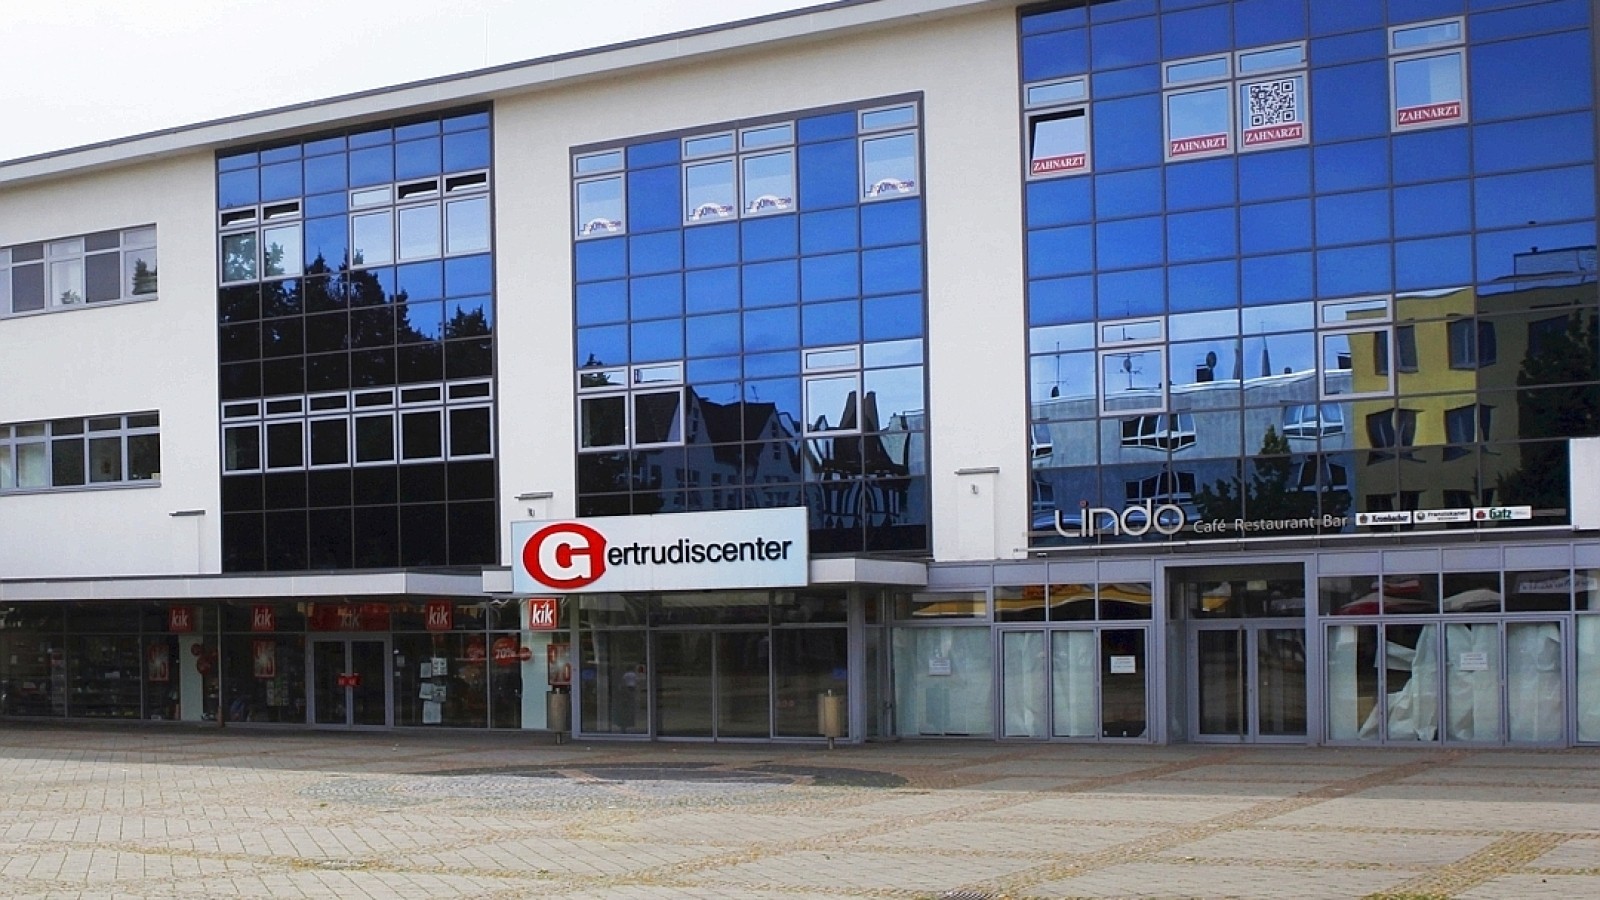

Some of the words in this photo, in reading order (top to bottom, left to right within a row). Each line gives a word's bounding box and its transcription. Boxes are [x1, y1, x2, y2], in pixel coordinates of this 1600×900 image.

[1400, 105, 1459, 122] ZAHNARZT
[1245, 127, 1301, 142] ZAHNARZT
[1172, 138, 1226, 152] ZAHNARZT
[1033, 156, 1084, 171] ZAHNARZT
[1489, 507, 1512, 520] Gatz
[1193, 518, 1226, 533] Café
[1234, 516, 1315, 531] Restaurant
[1323, 514, 1347, 528] Bar
[538, 531, 793, 580] Gertrudiscenter
